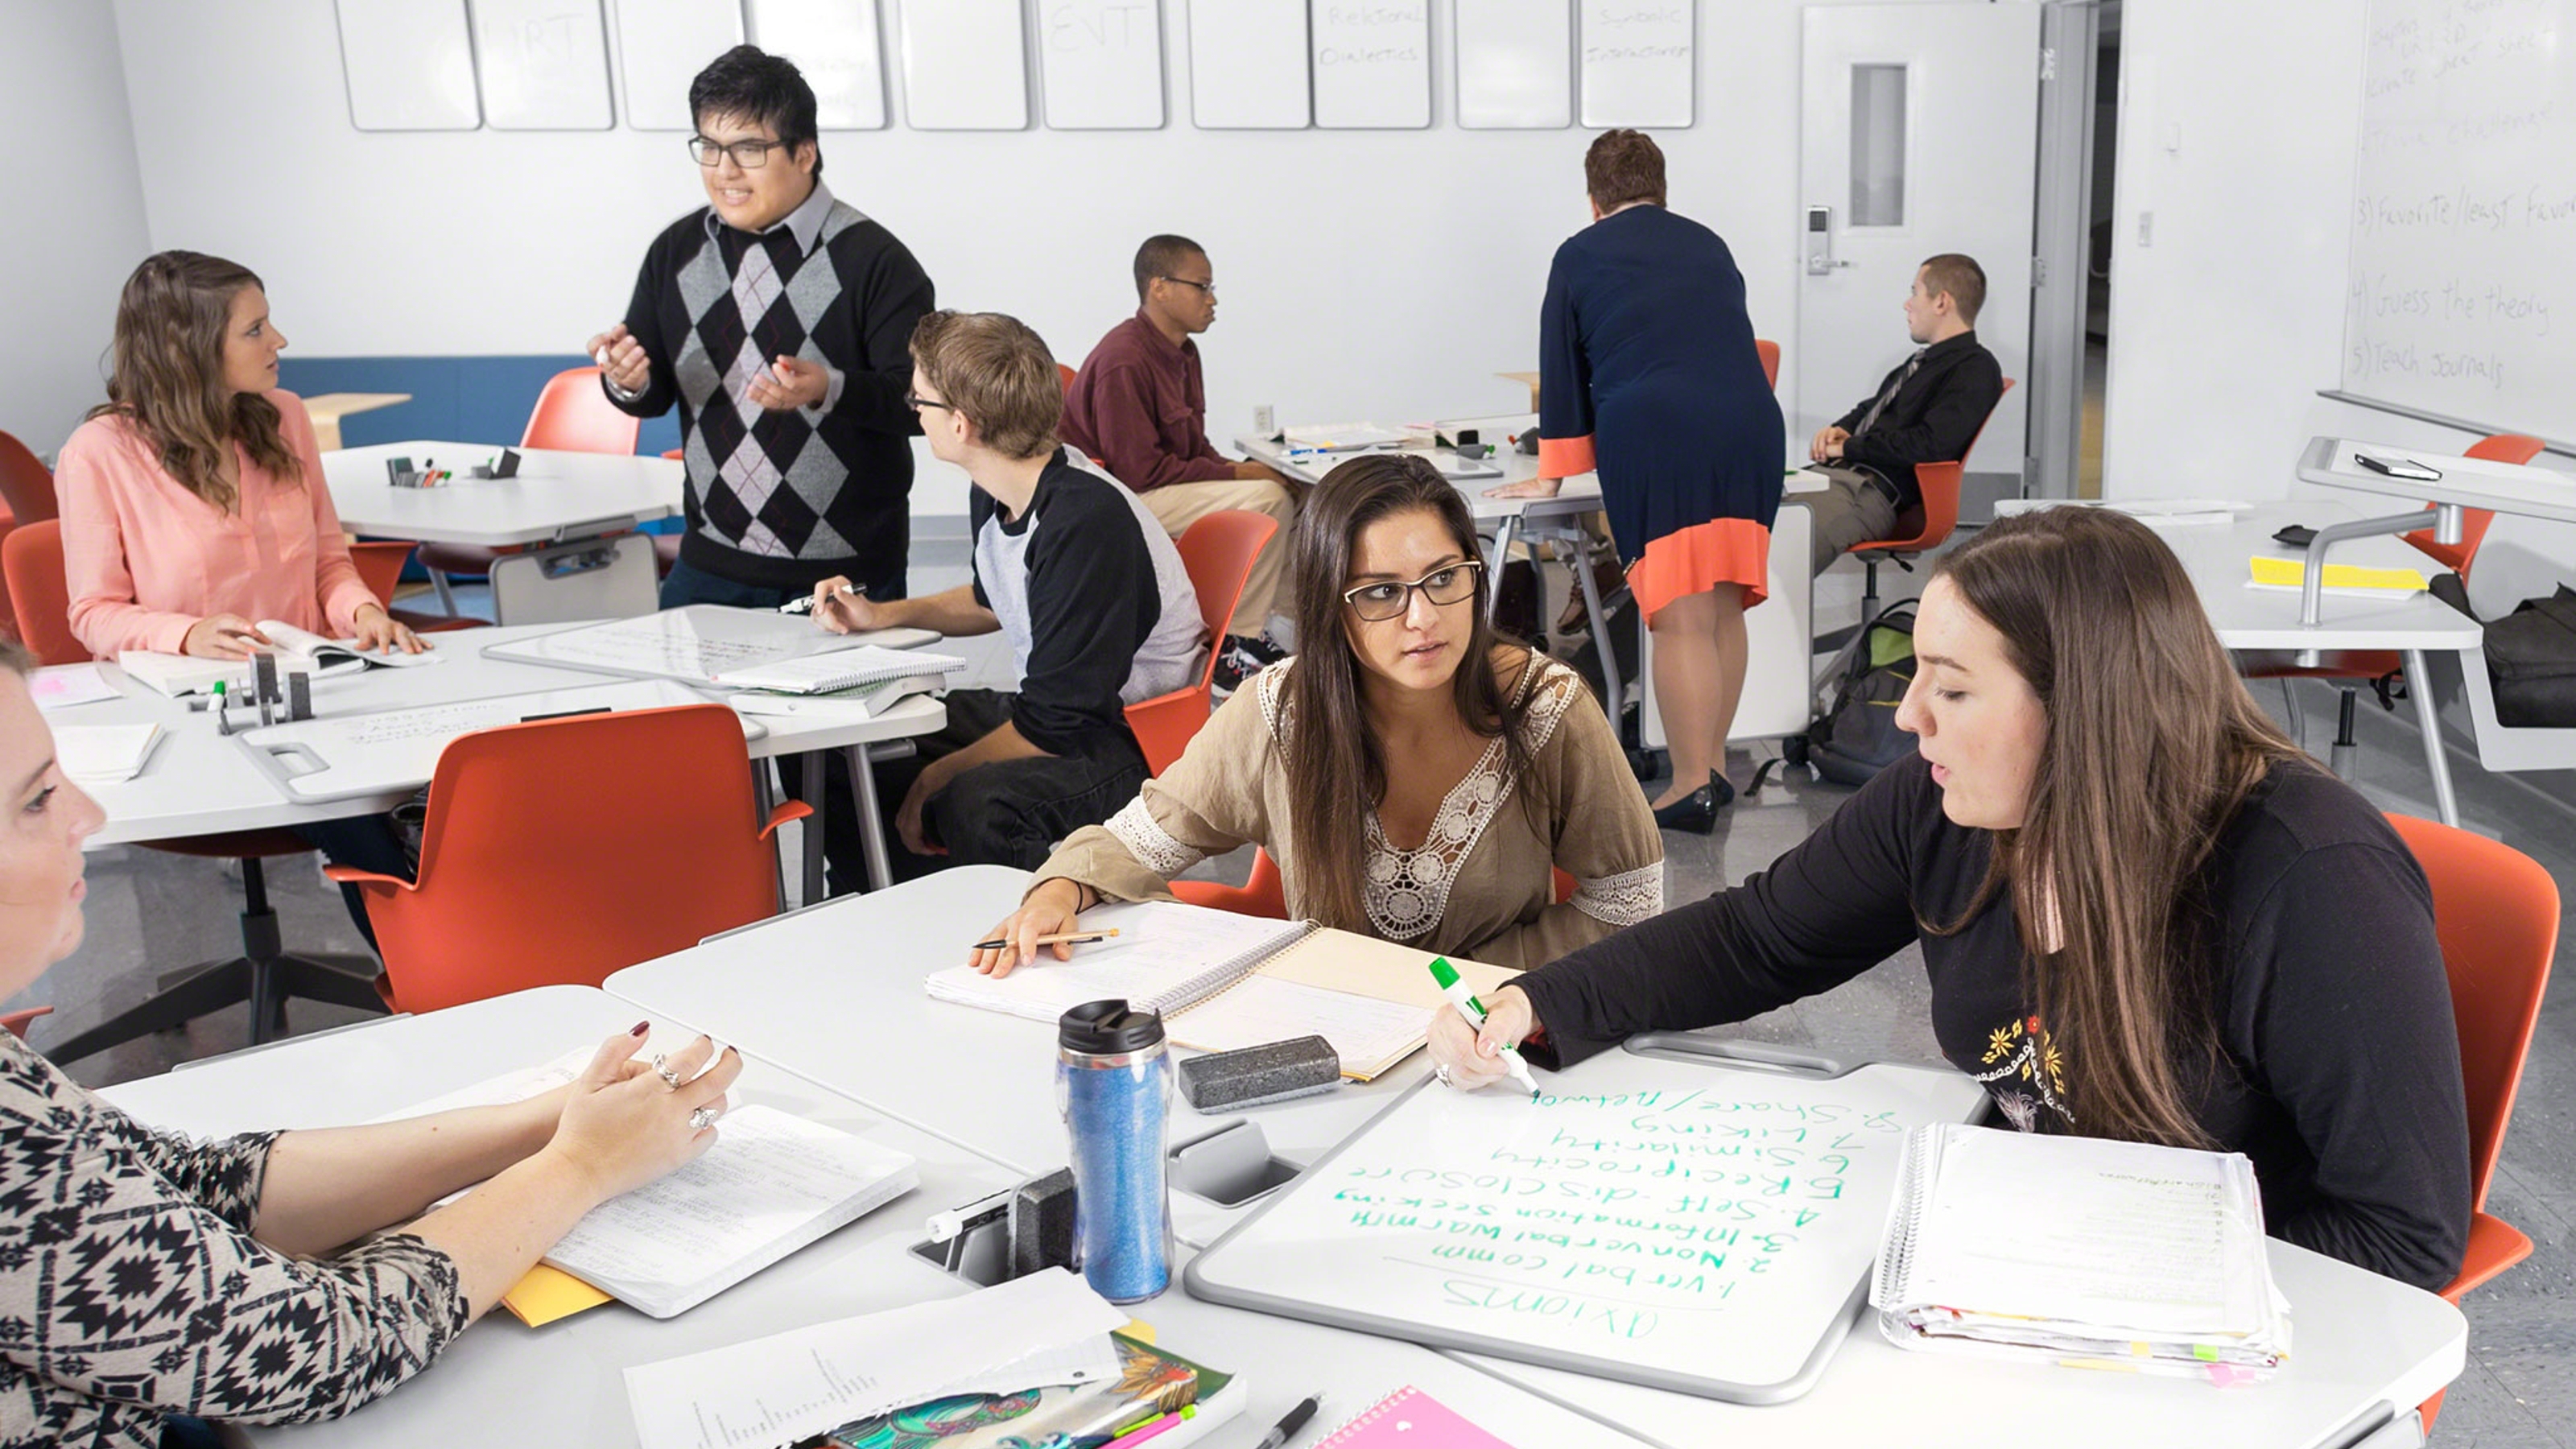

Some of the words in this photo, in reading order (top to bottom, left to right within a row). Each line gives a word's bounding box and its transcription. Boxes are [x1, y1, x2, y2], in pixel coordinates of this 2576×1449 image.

[1050, 4, 1147, 52] EVT
[2441, 277, 2476, 320] the
[2484, 283, 2550, 337] theory
[1490, 1146, 1792, 1195] Reciprocity
[1550, 1128, 1806, 1166] Similarity
[1513, 1232, 1727, 1269] Nonverbal
